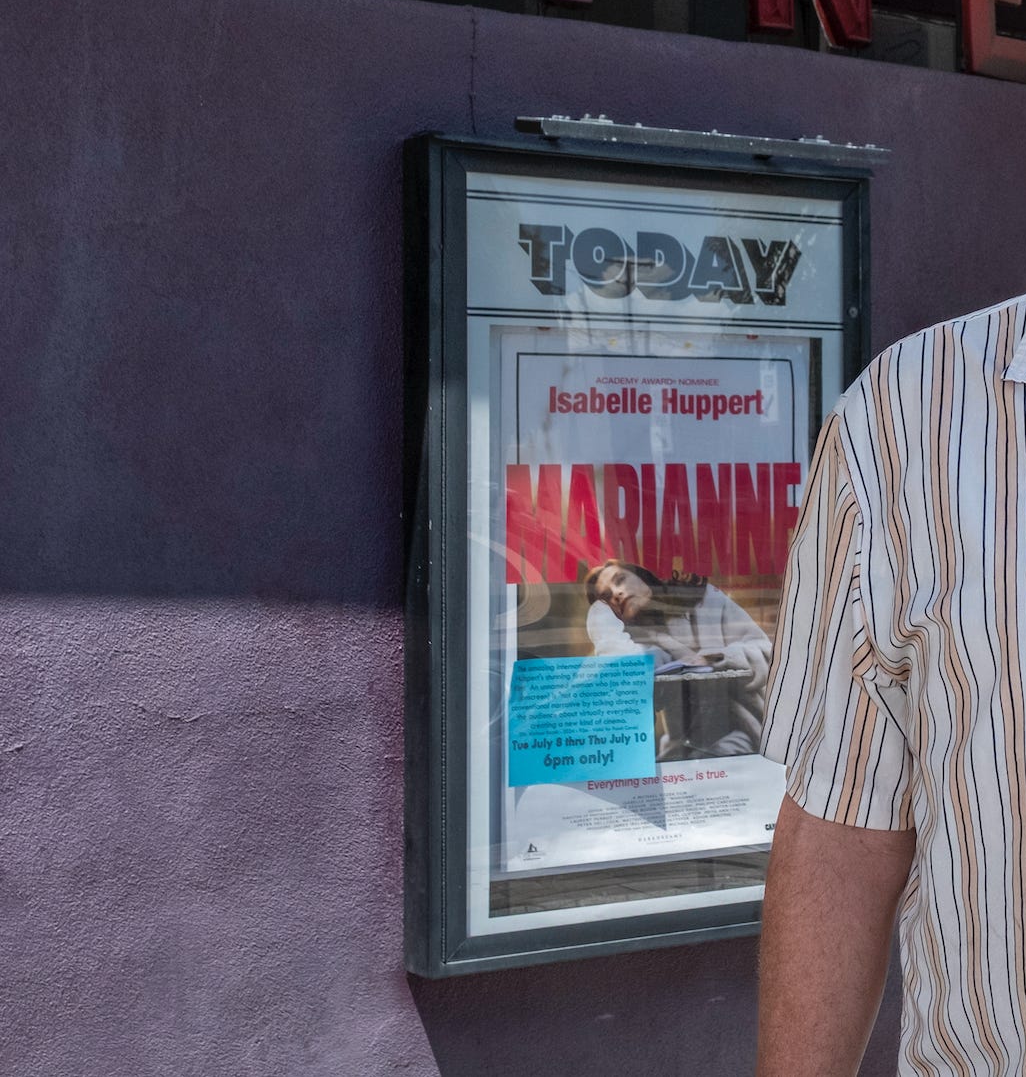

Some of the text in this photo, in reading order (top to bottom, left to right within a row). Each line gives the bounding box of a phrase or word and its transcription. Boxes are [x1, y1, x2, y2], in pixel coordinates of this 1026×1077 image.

[518, 223, 802, 307] TODAY
[596, 377, 638, 385] ACADEMY
[678, 379, 719, 387] NOMINEE
[549, 386, 764, 421] Isabelle Huppert
[506, 462, 801, 585] MARIANNE
[512, 740, 528, 751] Tue
[531, 738, 553, 750] July
[565, 736, 585, 746] thru
[588, 735, 607, 745] Thu
[609, 733, 632, 745] July
[634, 732, 647, 743] 10
[544, 749, 614, 770] 6pm only!
[587, 778, 639, 792] Everything
[662, 772, 694, 785] says...
[696, 770, 704, 780] is
[706, 769, 728, 781] true.
